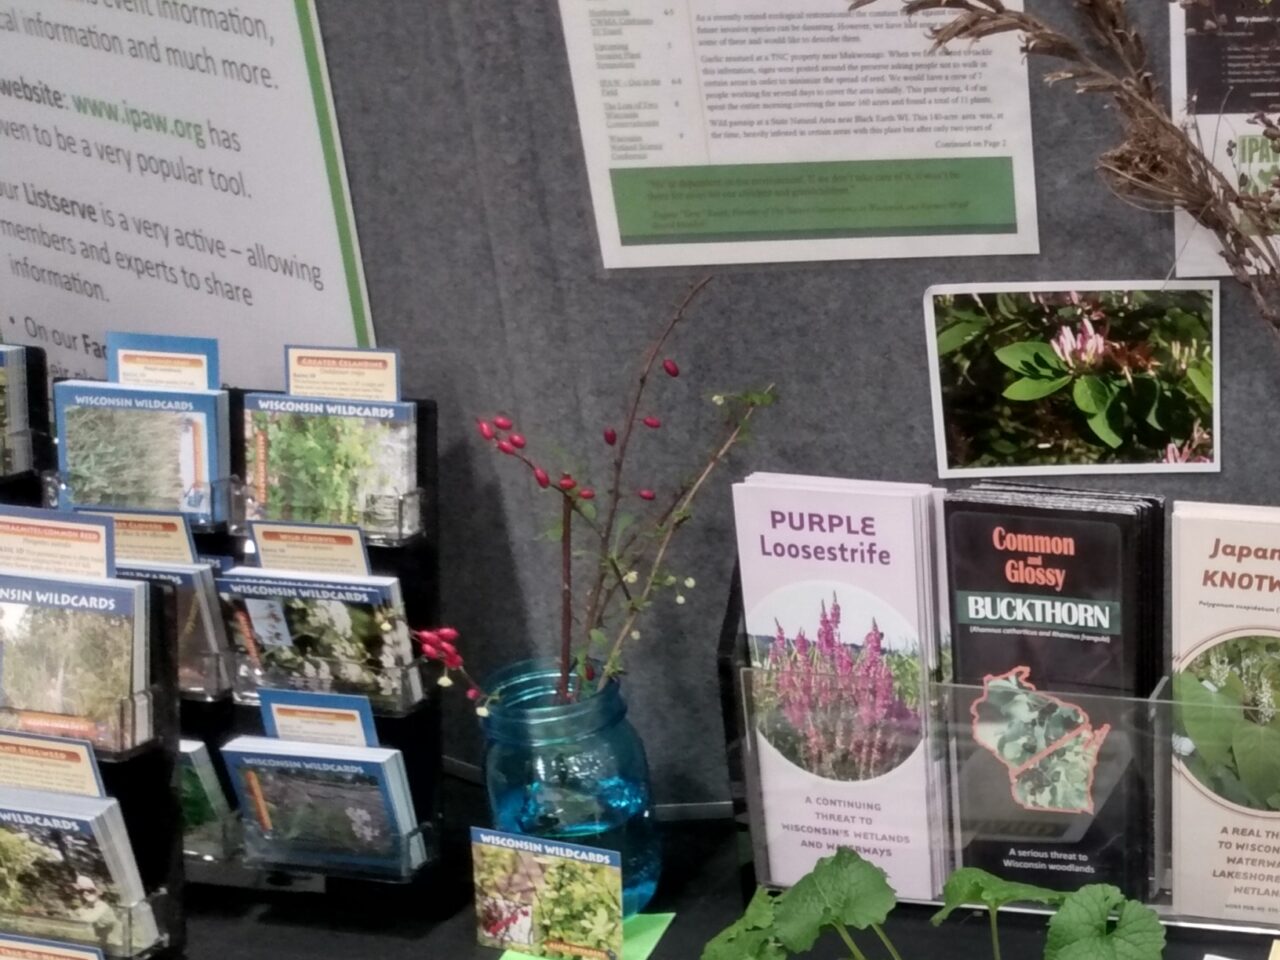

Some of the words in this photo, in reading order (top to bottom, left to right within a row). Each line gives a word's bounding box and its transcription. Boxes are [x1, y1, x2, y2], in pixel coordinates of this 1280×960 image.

[158, 0, 275, 47] information,
[23, 15, 124, 55] information
[128, 34, 161, 64] and
[165, 42, 217, 77] much
[222, 58, 279, 89] more.
[1, 77, 69, 110] website:
[72, 94, 206, 149] www.ipaw.org
[209, 119, 241, 153] has
[95, 141, 132, 172] very
[137, 154, 204, 186] popular
[209, 167, 252, 198] tool.
[24, 183, 98, 223] Listserve
[101, 202, 115, 228] is
[132, 216, 169, 247] very
[174, 227, 226, 258] active
[247, 245, 324, 291] allowing
[75, 394, 131, 409] WISCONSIN
[133, 398, 194, 411] WILDCARDS
[258, 399, 324, 415] WISCONSIN
[325, 403, 395, 419] WILDCARDS
[770, 510, 876, 537] PURPLE
[760, 534, 890, 565] Loosestrife
[993, 526, 1075, 556] Common
[1005, 559, 1066, 590] Glossy
[230, 583, 296, 598] WISCONSIN
[298, 587, 370, 604] WILDCARDS
[967, 596, 1110, 629] BUCKTHORN
[815, 796, 882, 812] CONTINUING
[815, 811, 856, 824] THREAT
[859, 815, 873, 825] TO
[782, 822, 849, 838] WISCONSIN'S
[853, 829, 910, 844] WETLANDS
[1218, 841, 1234, 850] TO
[1232, 828, 1262, 839] REAL
[480, 833, 542, 853] WISCONSIN
[544, 841, 610, 865] WILDCARDS
[1017, 849, 1048, 860] serious
[1050, 851, 1077, 862] threat
[1079, 854, 1088, 862] to
[1003, 859, 1046, 871] Wisconsin
[1048, 862, 1095, 874] woodlands
